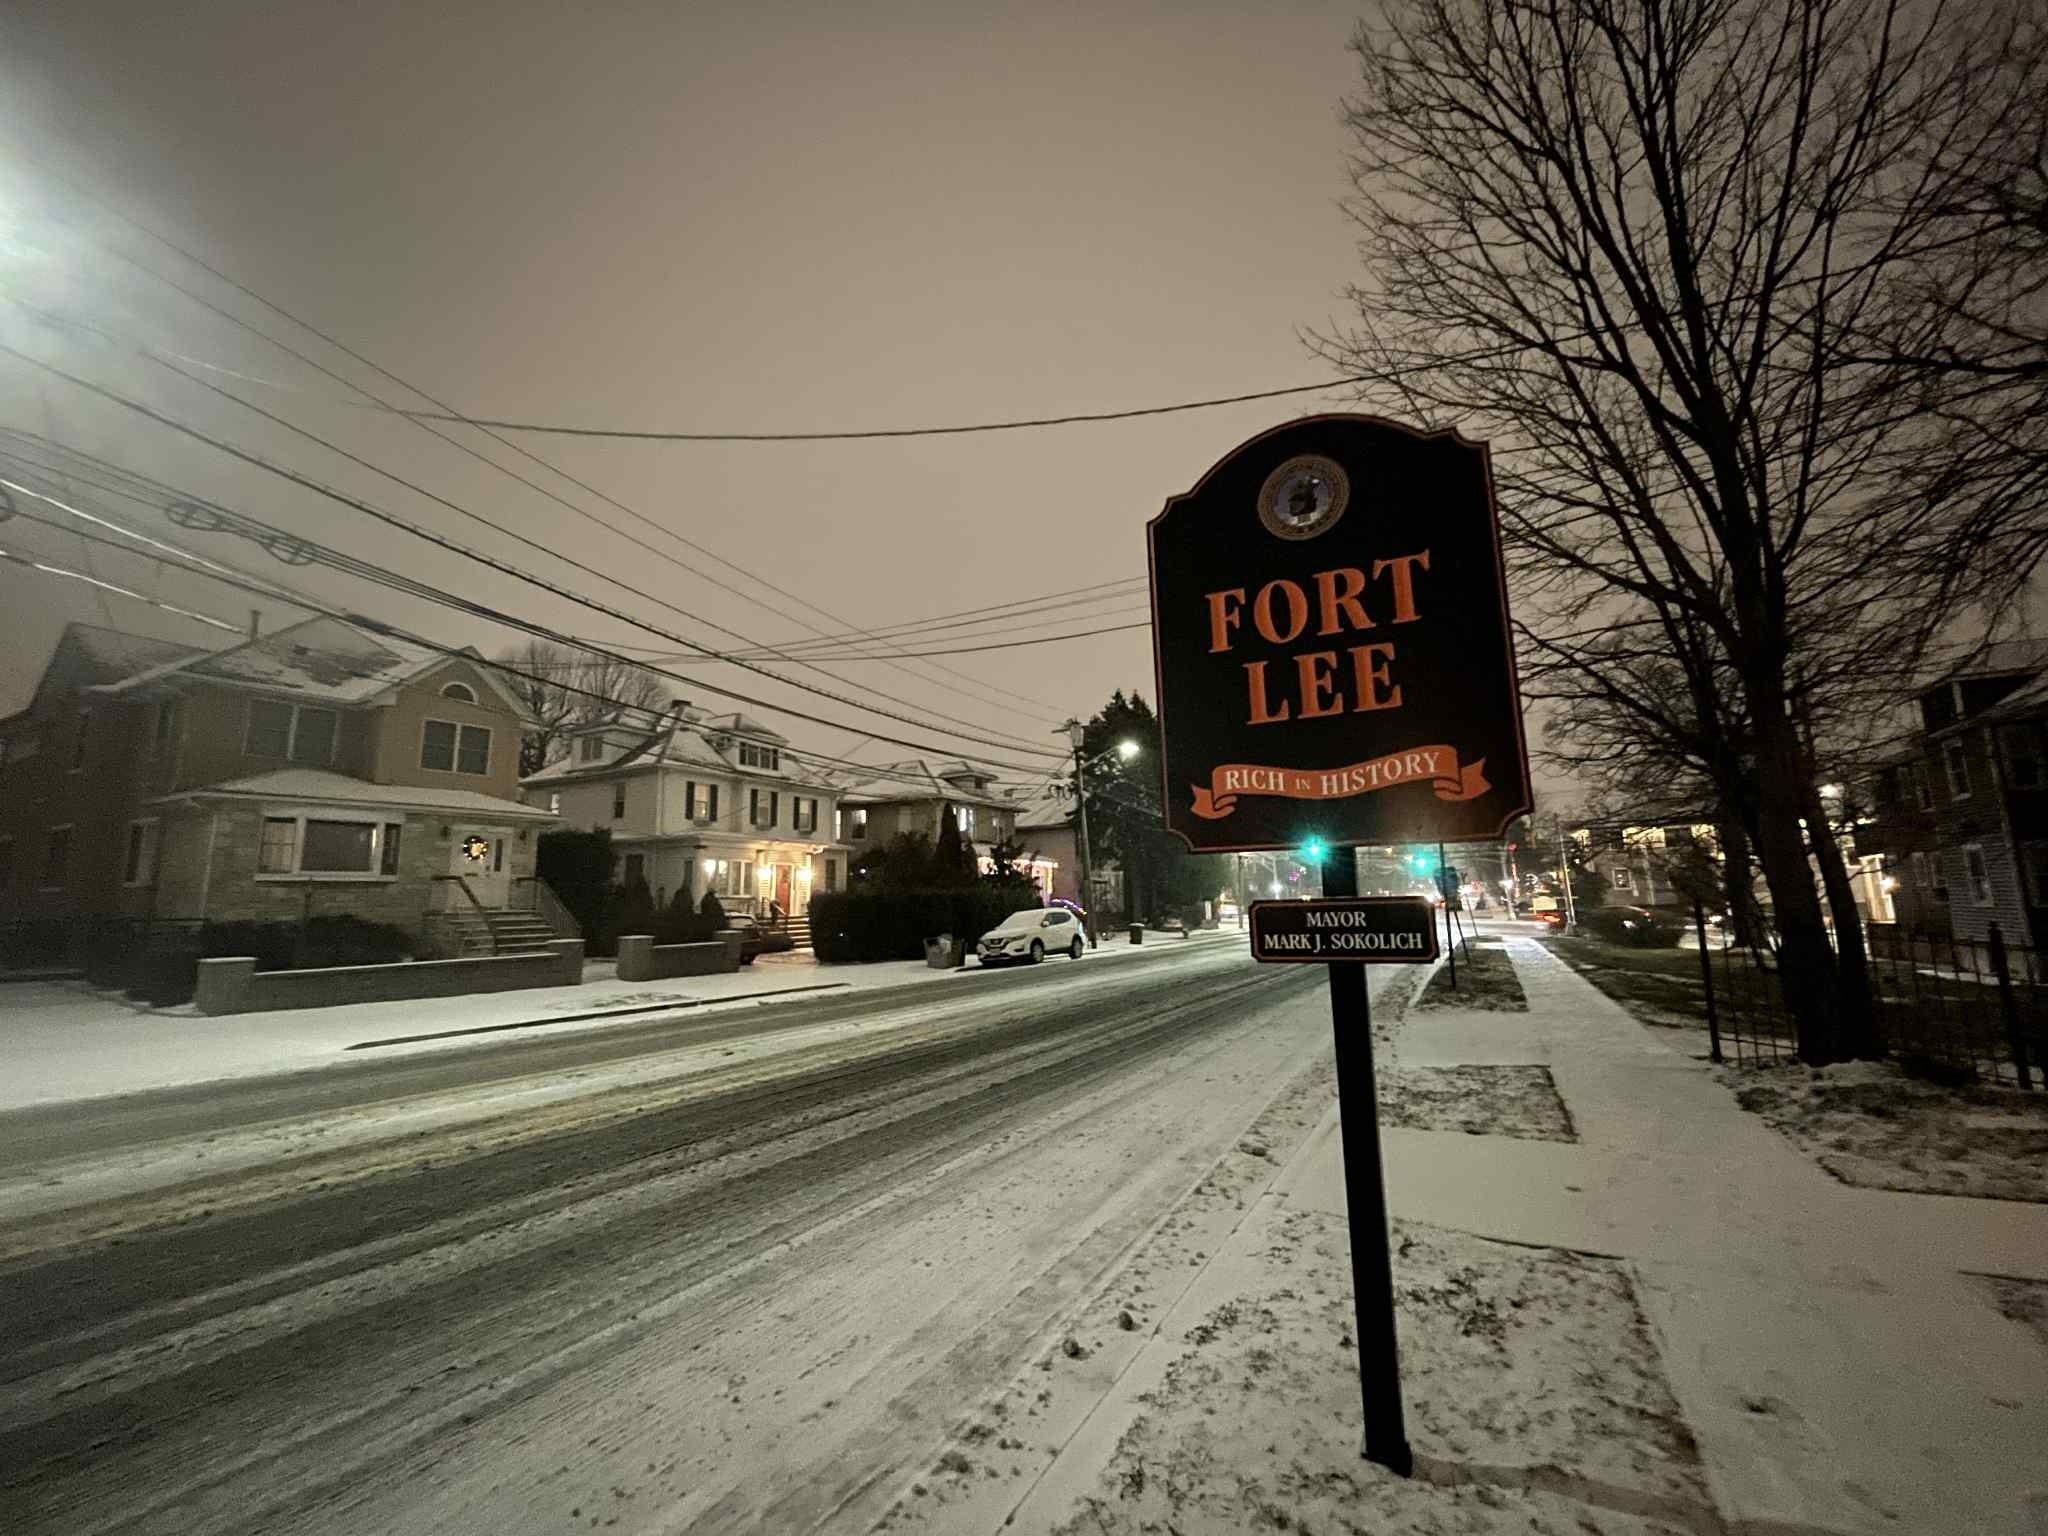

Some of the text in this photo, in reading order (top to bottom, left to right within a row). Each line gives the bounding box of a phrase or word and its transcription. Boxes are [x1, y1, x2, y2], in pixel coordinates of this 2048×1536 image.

[1204, 548, 1431, 654] FORT
[1241, 642, 1403, 726] LEE
[1224, 751, 1441, 796] RICH IN HISTORY
[1306, 911, 1368, 927] MAYOR
[1264, 932, 1423, 953] MARK J. SOKOLICH
